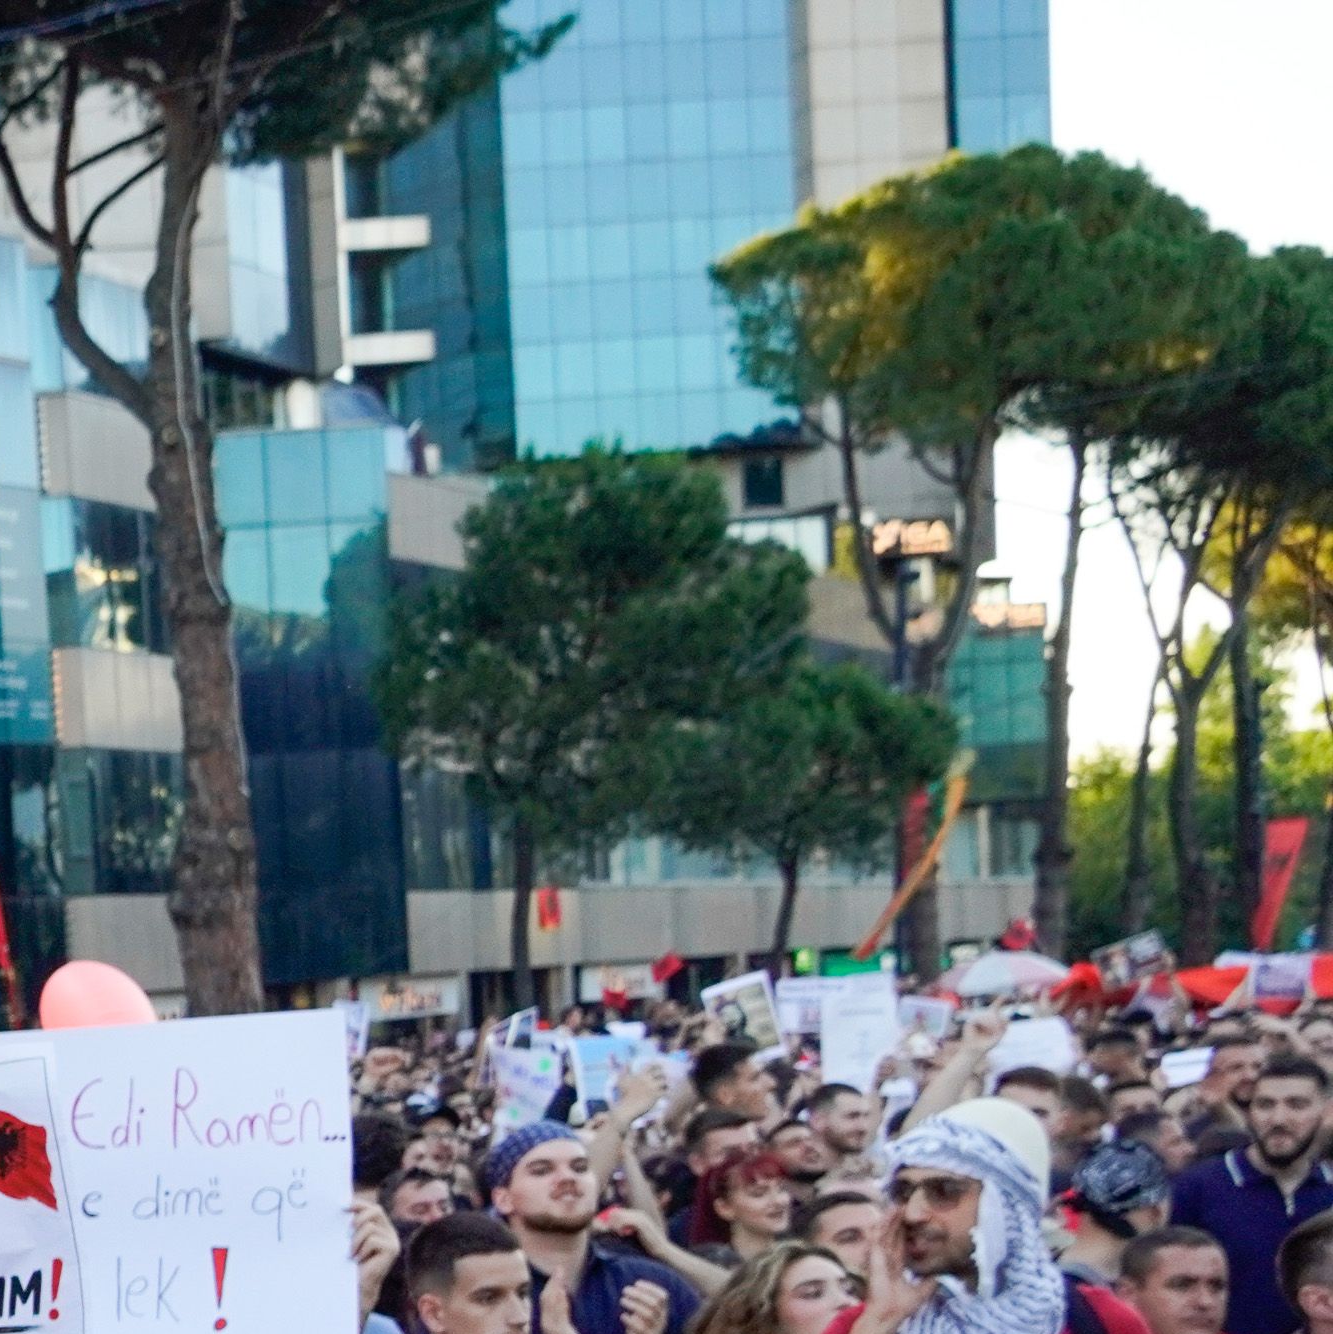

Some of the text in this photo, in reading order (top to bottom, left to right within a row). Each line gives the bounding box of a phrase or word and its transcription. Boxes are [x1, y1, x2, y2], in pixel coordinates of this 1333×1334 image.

[71, 1076, 145, 1150] Edi
[81, 1168, 309, 1242] e dimë që
